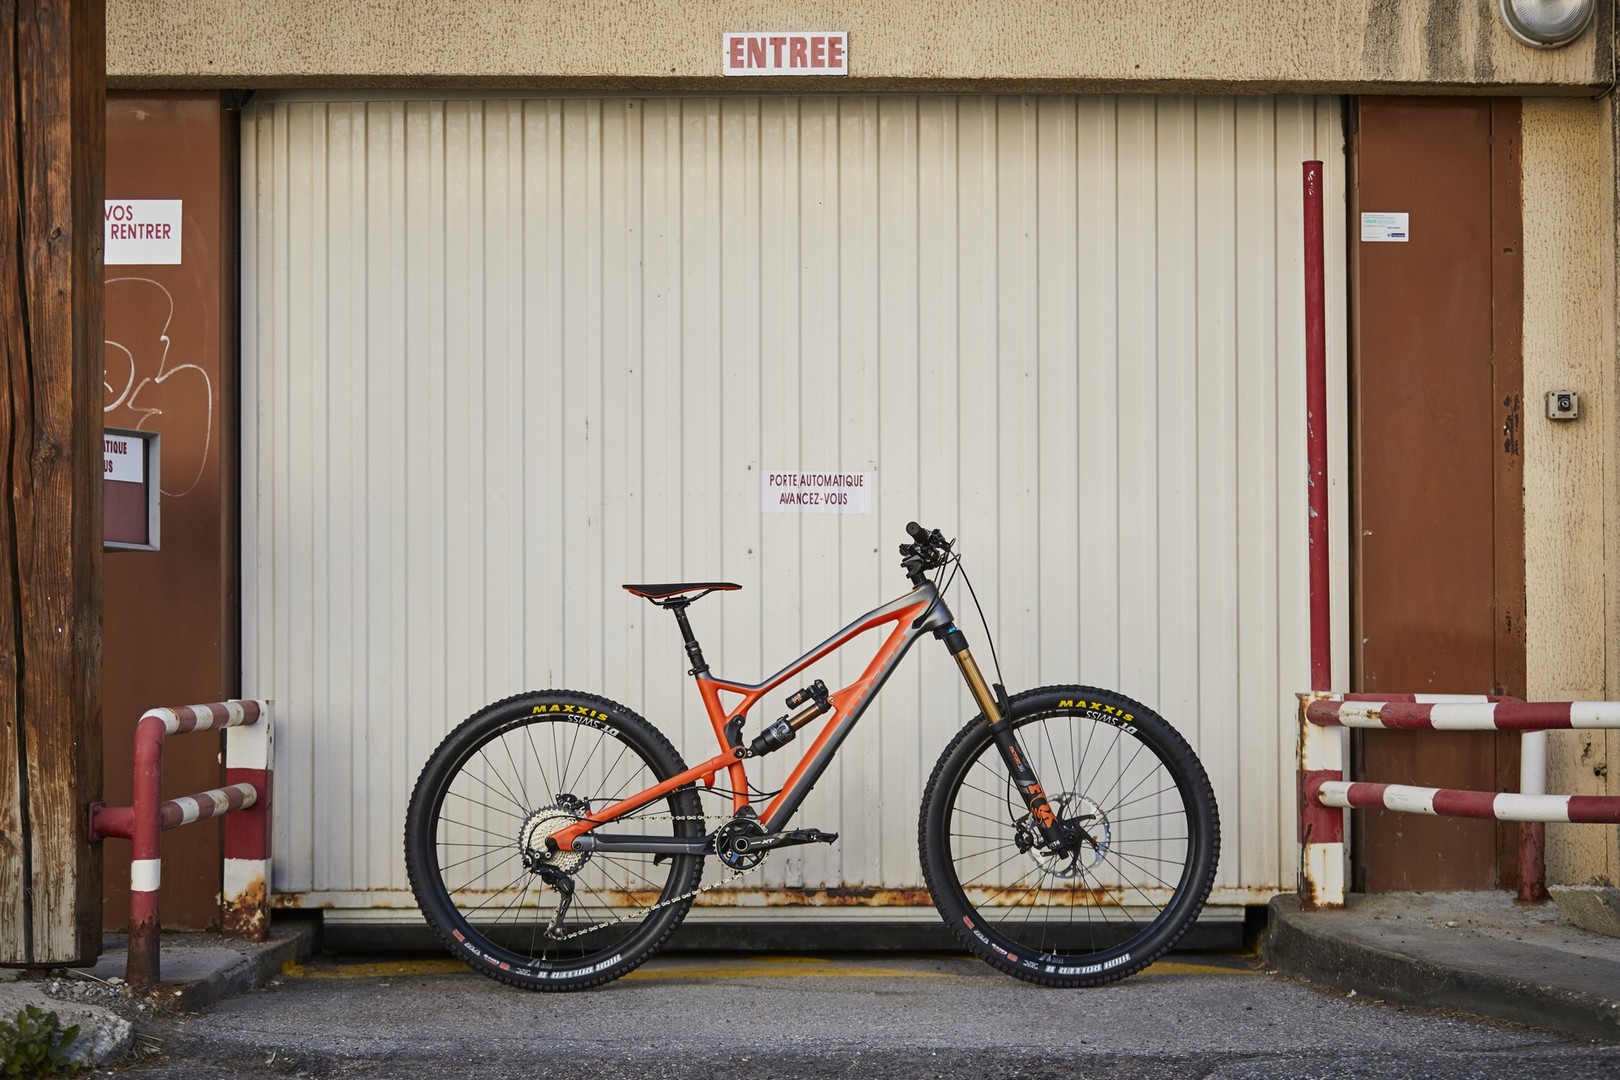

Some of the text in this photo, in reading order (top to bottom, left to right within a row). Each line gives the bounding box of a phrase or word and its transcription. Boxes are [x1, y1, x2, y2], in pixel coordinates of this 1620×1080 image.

[729, 36, 843, 69] ENTREE
[104, 205, 133, 221] VOS
[111, 223, 171, 239] RENTRER
[769, 474, 864, 487] PORTE AUTOMATIQUE
[779, 492, 848, 505] AVANCEZ-VOUS
[532, 704, 608, 721] MAXXIS
[1058, 700, 1135, 722] MAXXIS
[567, 714, 620, 737] DT SWISS
[1085, 710, 1138, 735] DT SWISS
